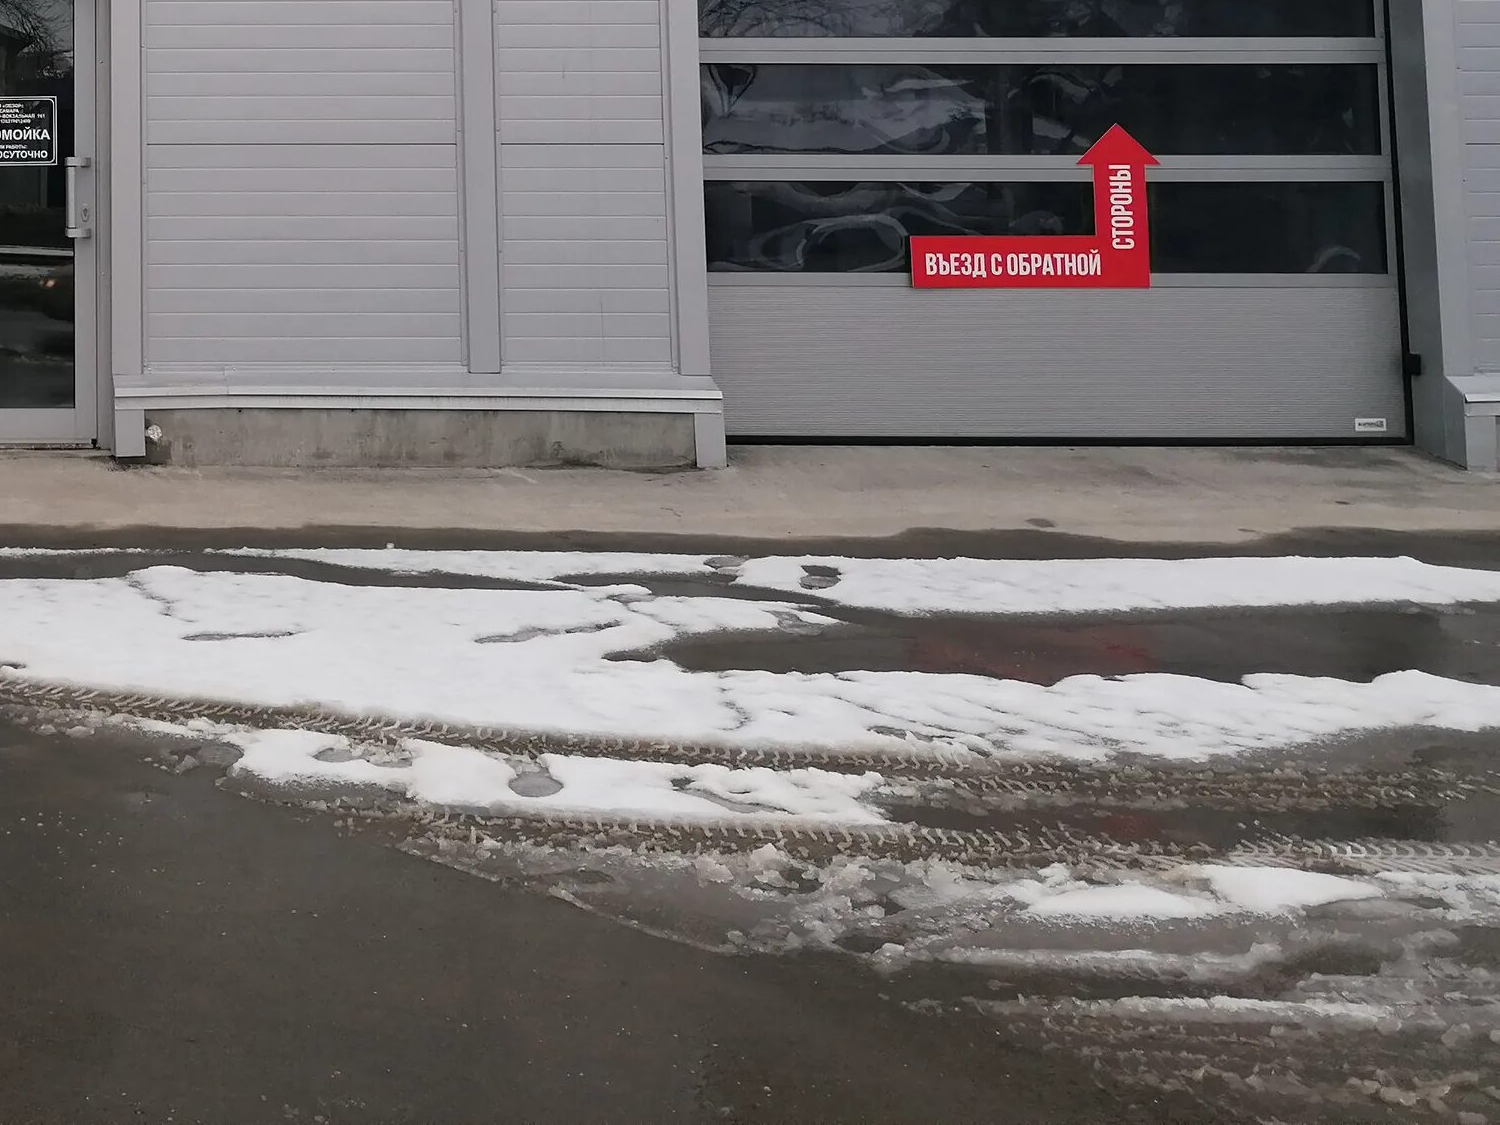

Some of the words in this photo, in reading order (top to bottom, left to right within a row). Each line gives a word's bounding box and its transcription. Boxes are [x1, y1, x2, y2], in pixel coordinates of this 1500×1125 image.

[1108, 164, 1135, 251] СТОРОНЫ
[925, 253, 987, 278] ВЪЕЗД
[990, 254, 1004, 276] С
[1006, 249, 1102, 277] ОБРАТНОЙ
